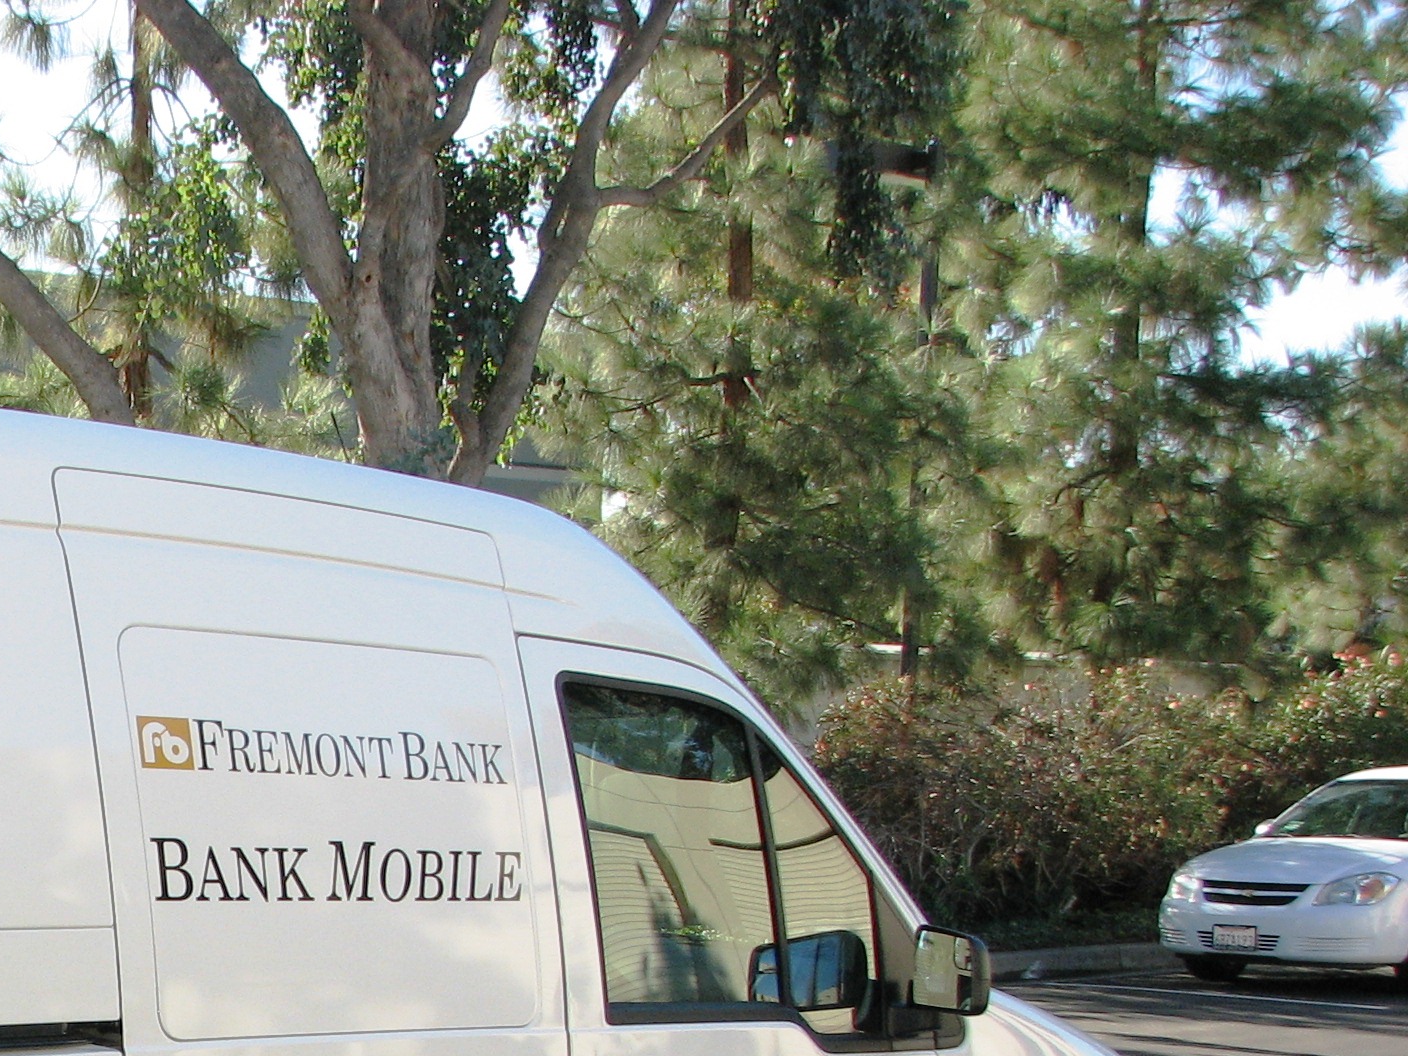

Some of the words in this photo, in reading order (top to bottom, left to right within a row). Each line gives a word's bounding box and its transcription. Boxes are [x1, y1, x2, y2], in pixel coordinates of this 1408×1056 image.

[398, 731, 508, 785] BANK
[150, 837, 316, 902] BANK
[327, 841, 523, 903] MOBILE
